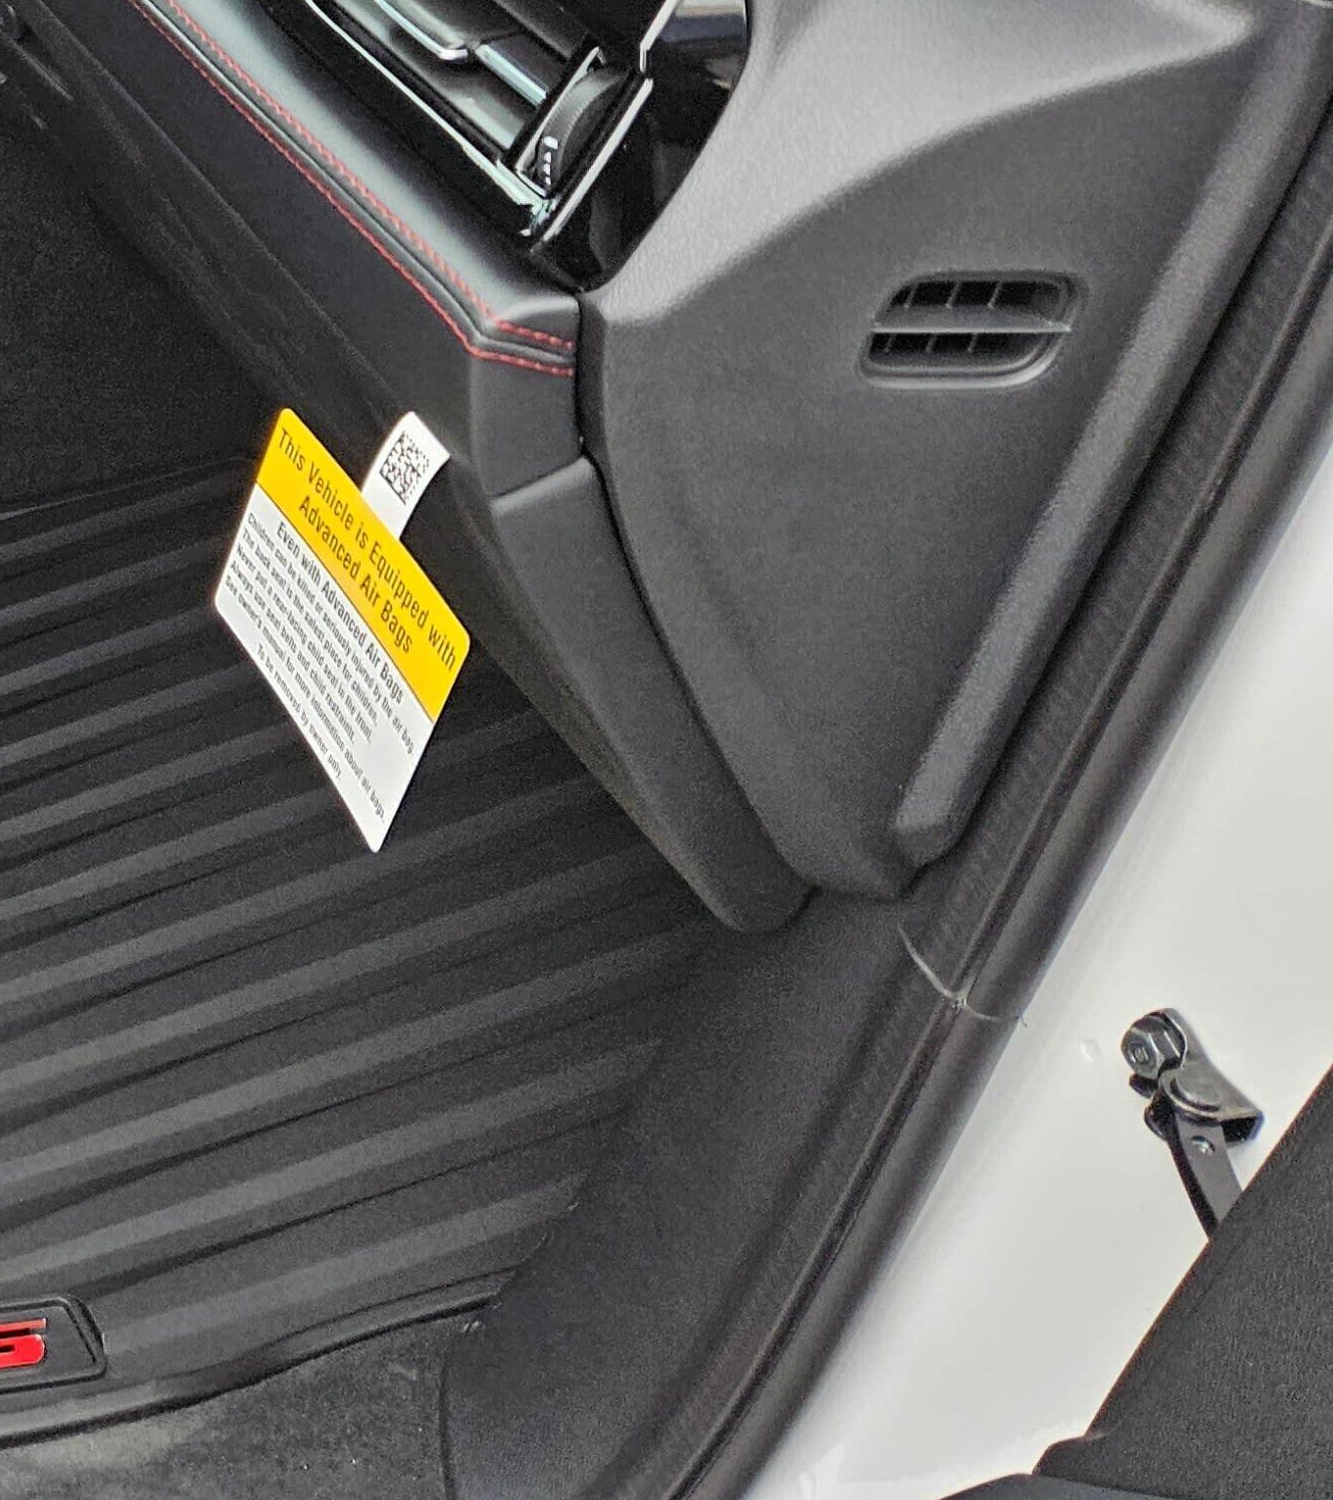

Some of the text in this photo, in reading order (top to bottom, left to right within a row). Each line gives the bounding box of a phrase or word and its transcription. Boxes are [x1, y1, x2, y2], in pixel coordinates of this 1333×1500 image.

[242, 528, 254, 549] The
[254, 543, 271, 571] back
[270, 566, 287, 590] seat
[293, 591, 305, 614] the
[304, 610, 325, 643] safest
[323, 639, 342, 668] place
[342, 663, 353, 682] for
[248, 512, 274, 550] Children
[275, 548, 287, 568] can
[287, 563, 297, 579] be
[297, 574, 316, 605] killed
[323, 612, 352, 657] seriously
[351, 653, 375, 689] injured
[373, 683, 382, 701] by
[381, 696, 393, 719] the
[392, 715, 402, 733] air
[277, 521, 404, 705] Even with Advanced Air Bags
[279, 427, 455, 671] This Vehicle is Equipped with
[299, 496, 412, 653] Advanced Air Bags
[254, 591, 266, 610] use
[266, 608, 281, 631] seat
[281, 626, 297, 653] belts
[297, 649, 309, 672] and
[309, 667, 327, 697] child
[272, 593, 308, 645] rear-facing
[307, 640, 325, 667] child
[323, 664, 338, 688] seat
[344, 695, 356, 716] the
[285, 655, 296, 675] for
[295, 672, 312, 698] more
[345, 748, 363, 780] about
[361, 776, 371, 794] air
